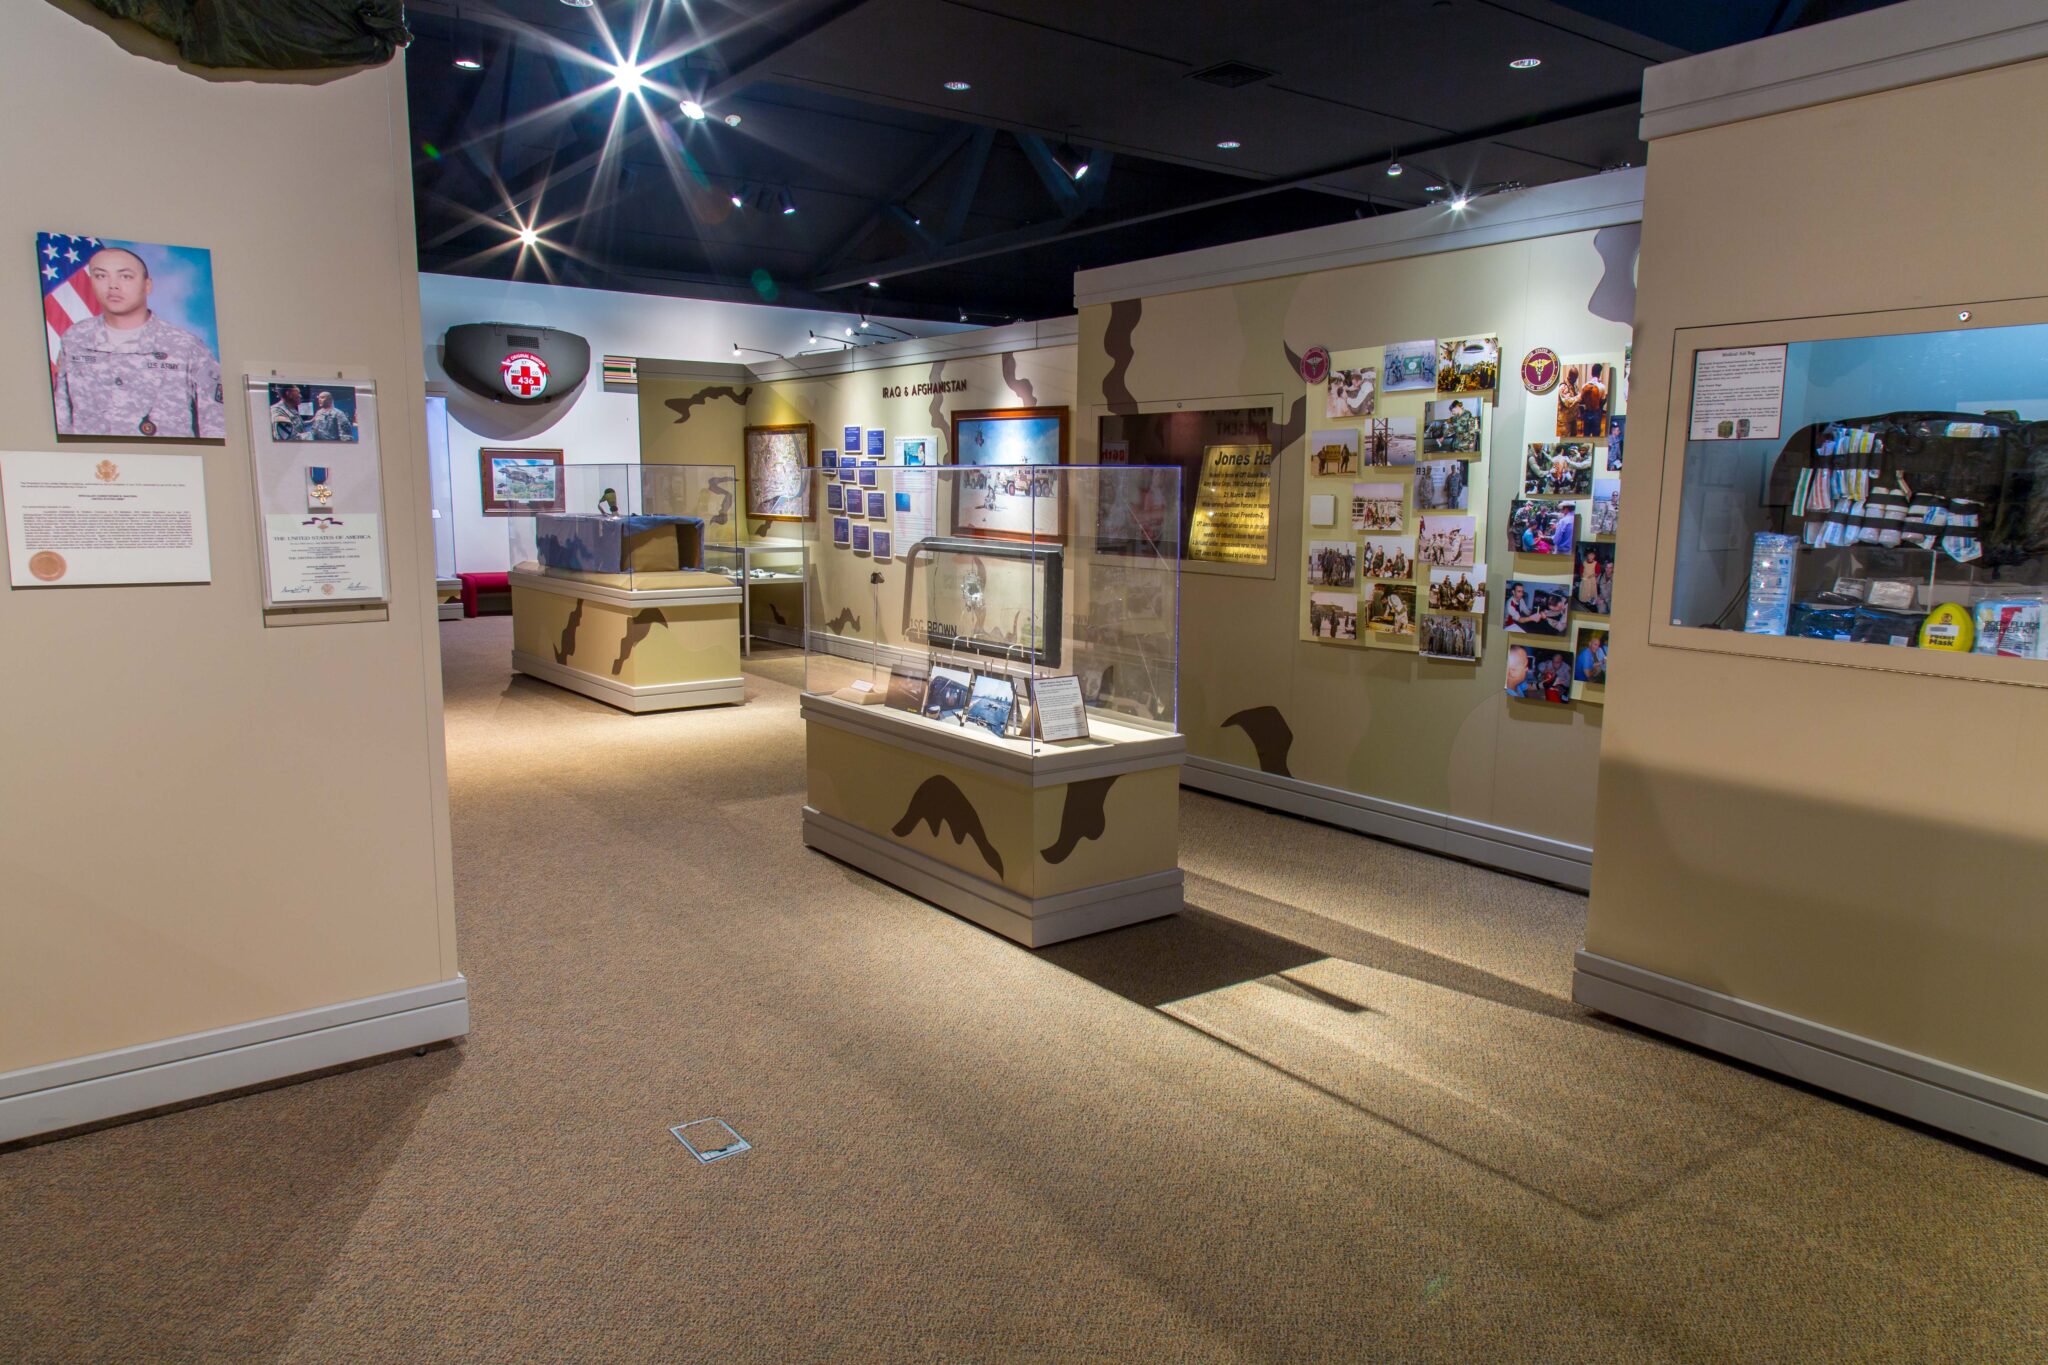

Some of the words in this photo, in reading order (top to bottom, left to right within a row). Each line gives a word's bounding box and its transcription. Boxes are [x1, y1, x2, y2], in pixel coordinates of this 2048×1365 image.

[882, 386, 901, 399] IRAQ
[904, 386, 909, 397] &
[911, 379, 968, 397] AFGHANISTAN
[1214, 450, 1251, 466] Jones
[927, 620, 957, 637] BROWN
[1928, 638, 1954, 647] Mask
